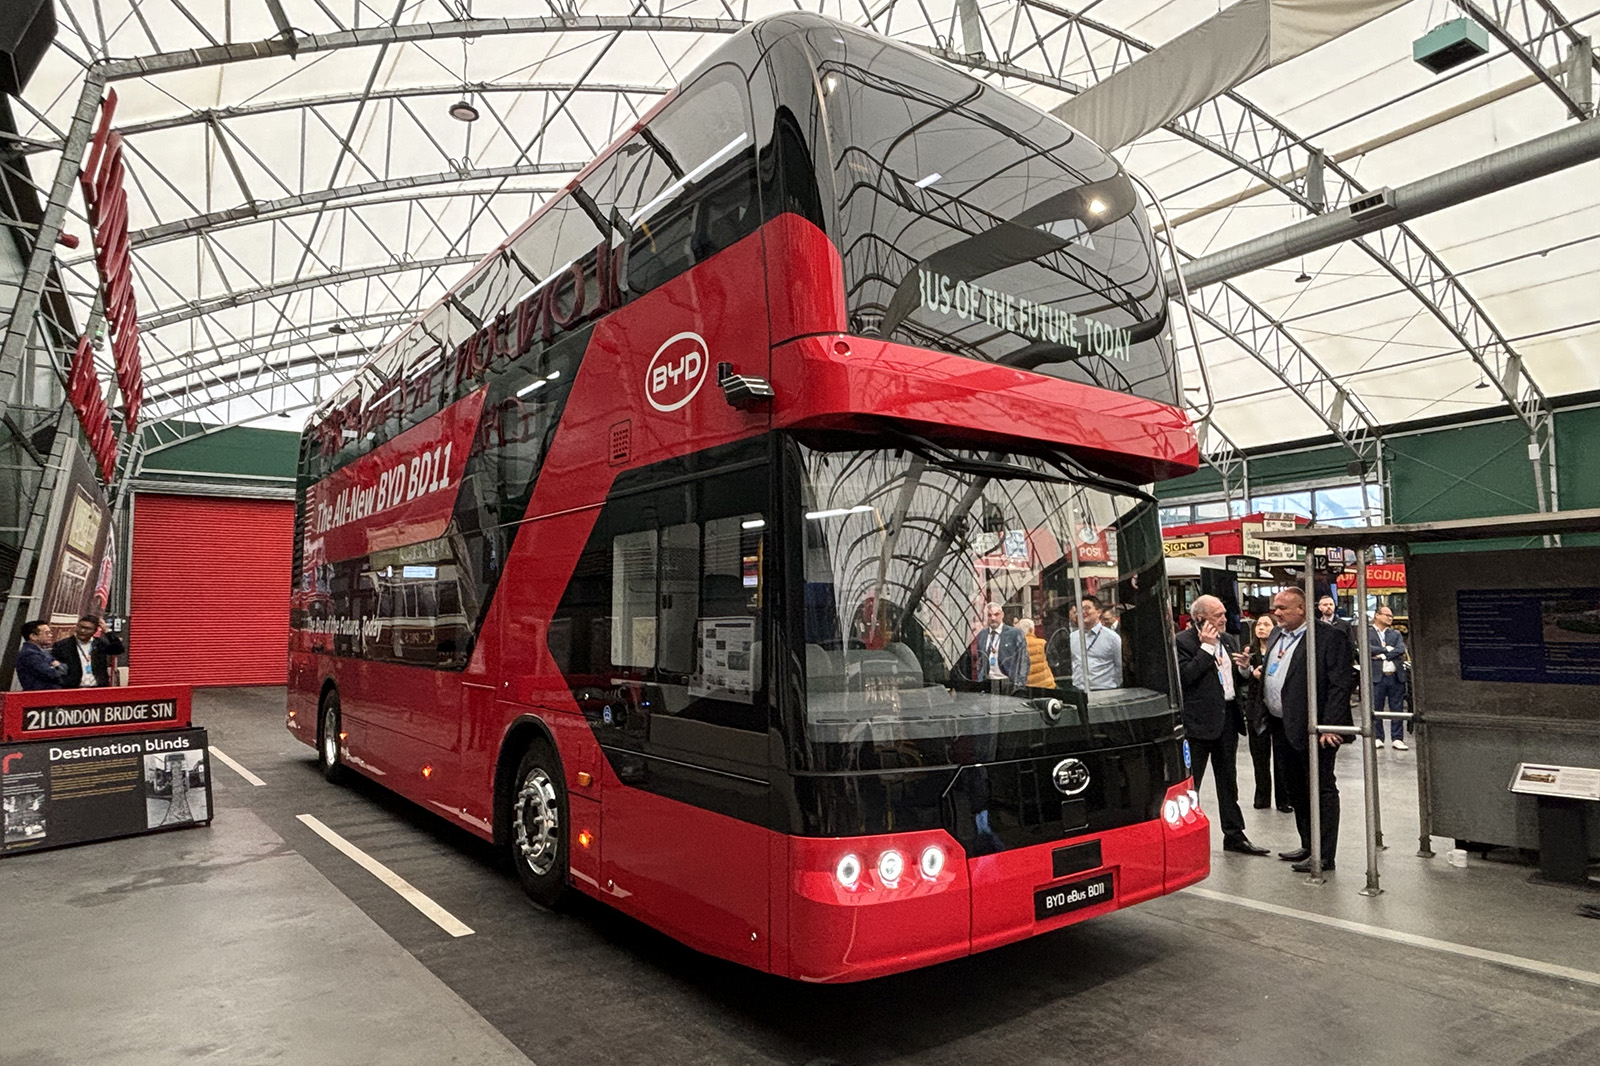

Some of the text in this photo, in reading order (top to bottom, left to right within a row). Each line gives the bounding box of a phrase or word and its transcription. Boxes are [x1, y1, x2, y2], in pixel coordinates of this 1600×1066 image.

[955, 280, 980, 321] OF
[983, 288, 1015, 332] THE
[1019, 298, 1081, 355] FUTURE,
[1084, 317, 1131, 362] TODAY
[653, 351, 701, 393] BYD
[316, 441, 453, 534] The All-New BYD BD11
[1315, 557, 1326, 569] 12
[362, 614, 382, 642] Today
[27, 702, 173, 730] 21 LONDON BRIDGE STN
[49, 736, 189, 761] Destination blinds
[1058, 769, 1087, 785] BYD
[1046, 893, 1065, 909] BYD
[1067, 889, 1086, 904] eBus
